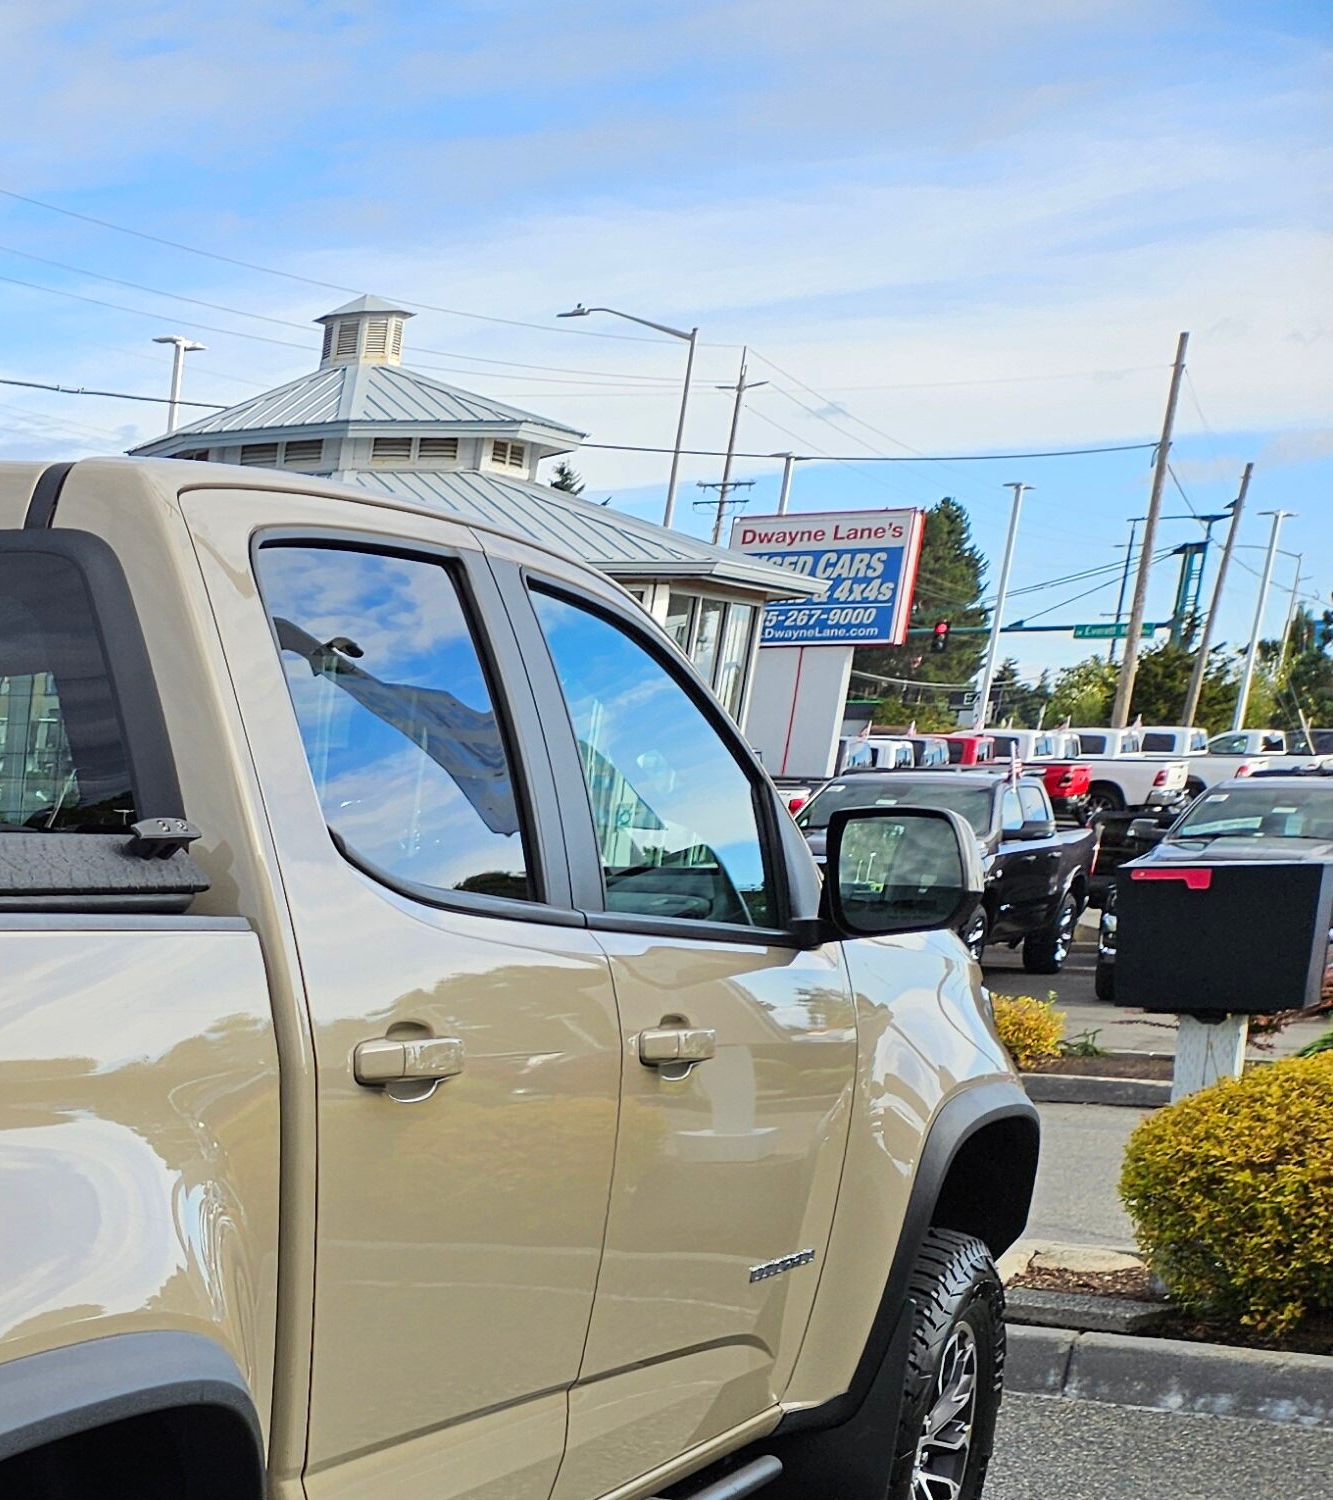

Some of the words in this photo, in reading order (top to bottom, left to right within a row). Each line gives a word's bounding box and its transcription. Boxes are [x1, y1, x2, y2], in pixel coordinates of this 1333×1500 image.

[741, 528, 826, 547] Dwayne
[833, 522, 905, 541] Lane's
[815, 552, 888, 579] CARS
[834, 578, 896, 602] 4x4s
[764, 607, 877, 627] 5-267-9000
